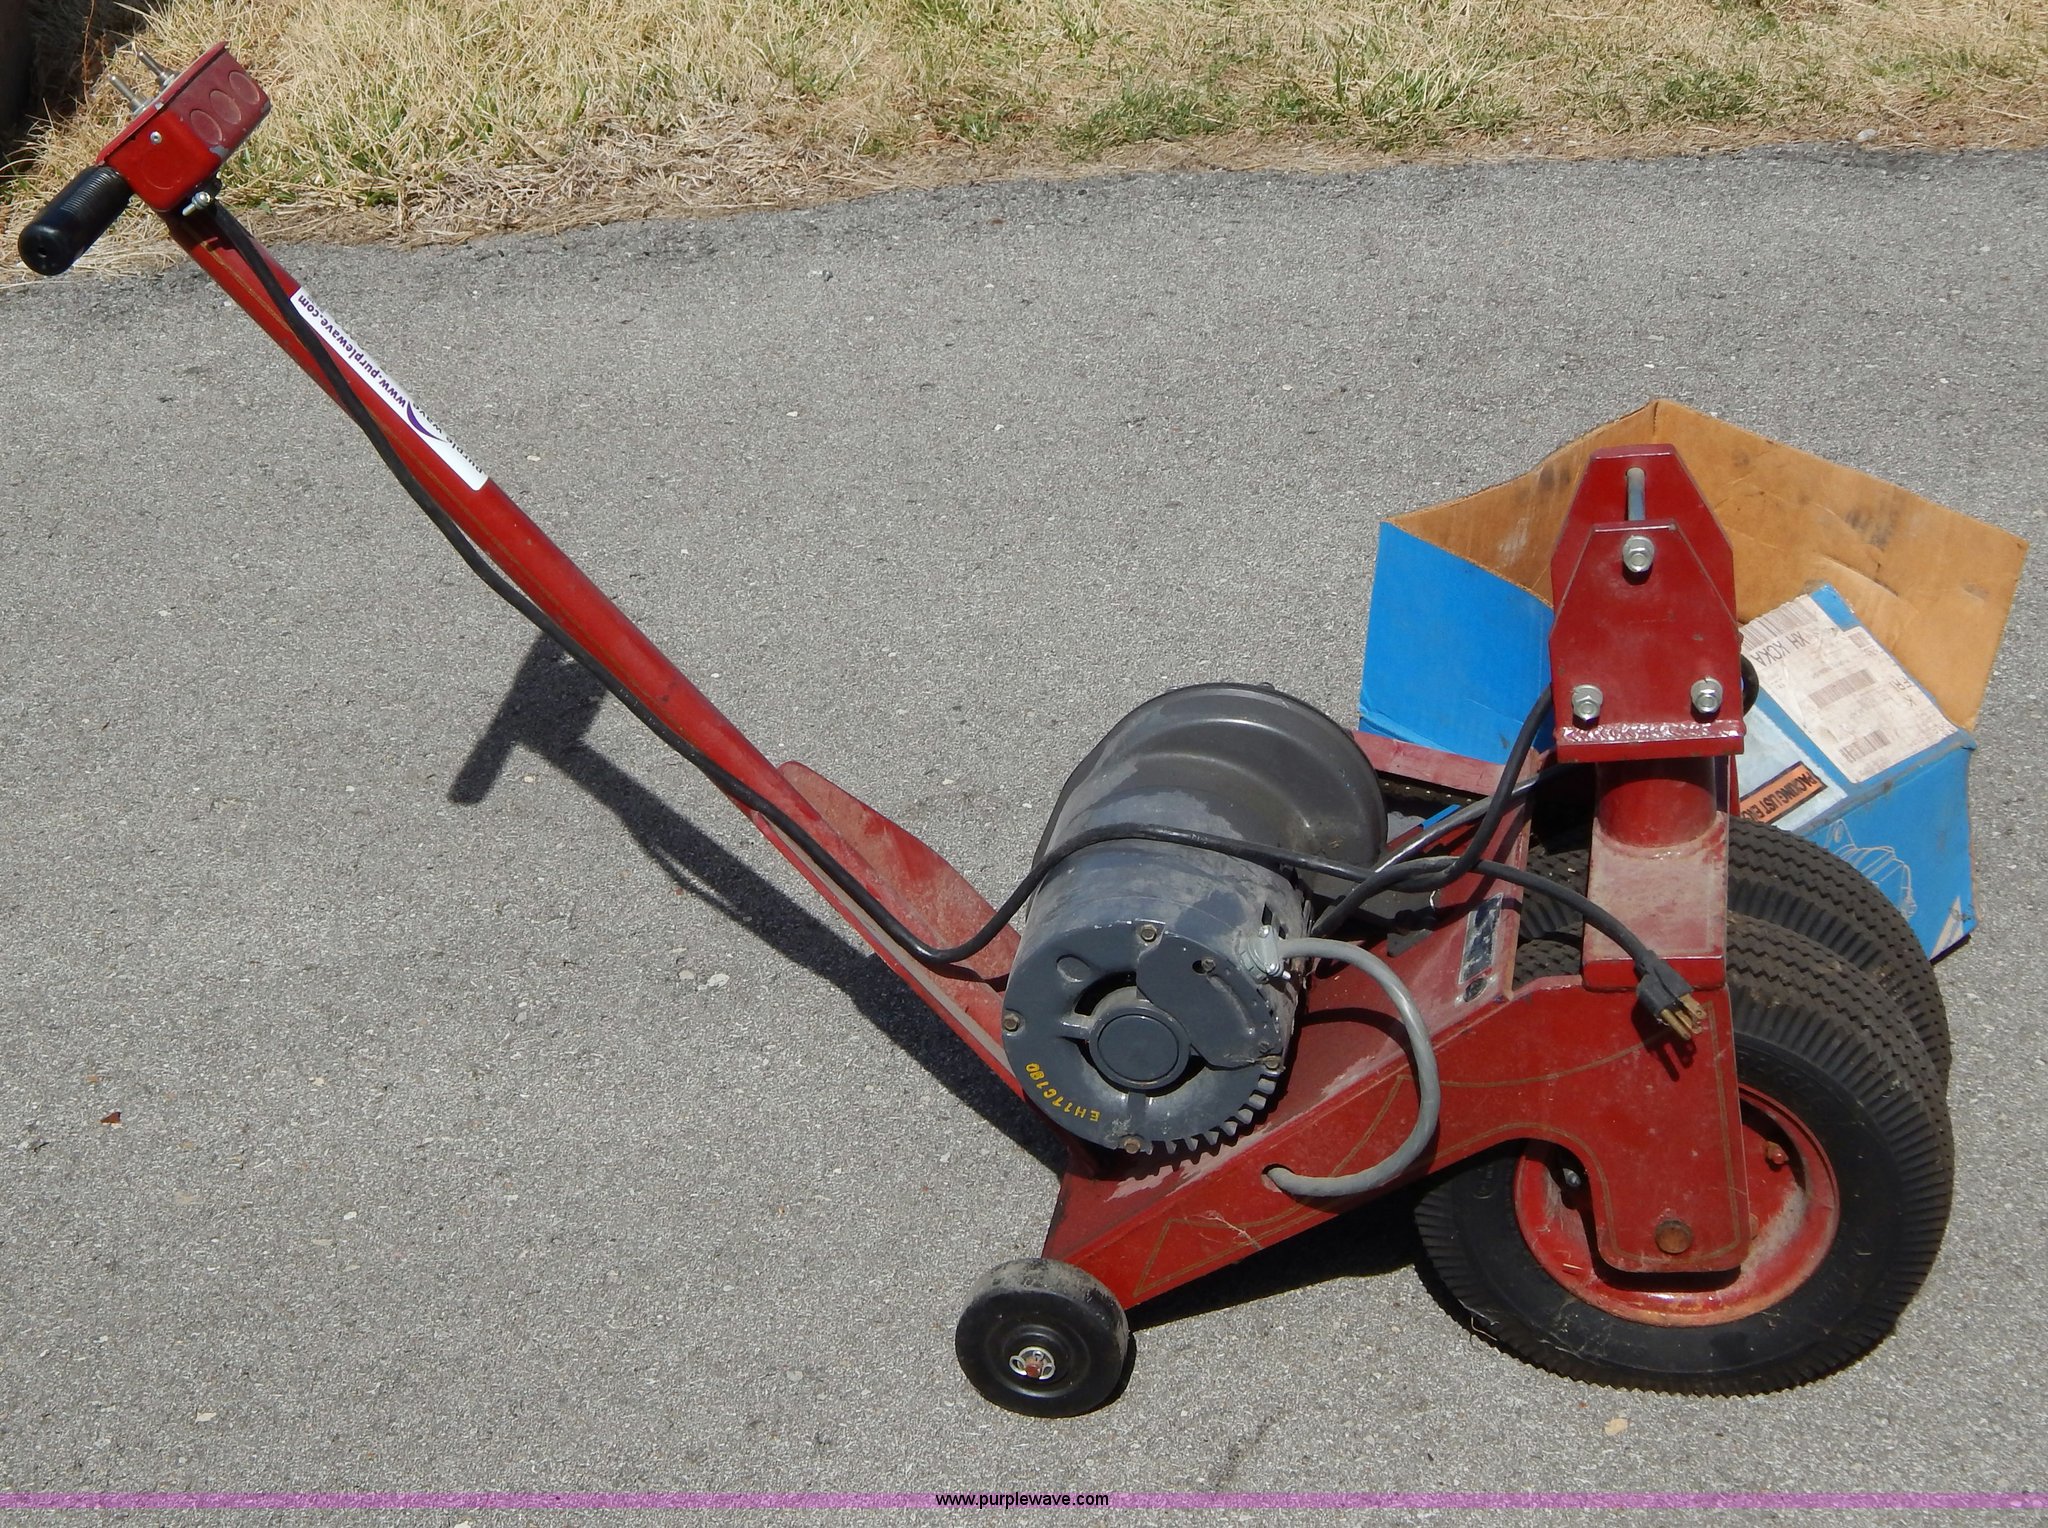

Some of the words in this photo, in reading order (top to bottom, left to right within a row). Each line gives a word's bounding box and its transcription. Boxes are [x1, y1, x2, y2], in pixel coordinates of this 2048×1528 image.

[298, 294, 406, 407] www.purplewave.com
[1750, 640, 1790, 667] KCKA
[1779, 771, 1818, 804] PACKING
[1742, 804, 1765, 820] ENC
[1760, 793, 1783, 814] LIST
